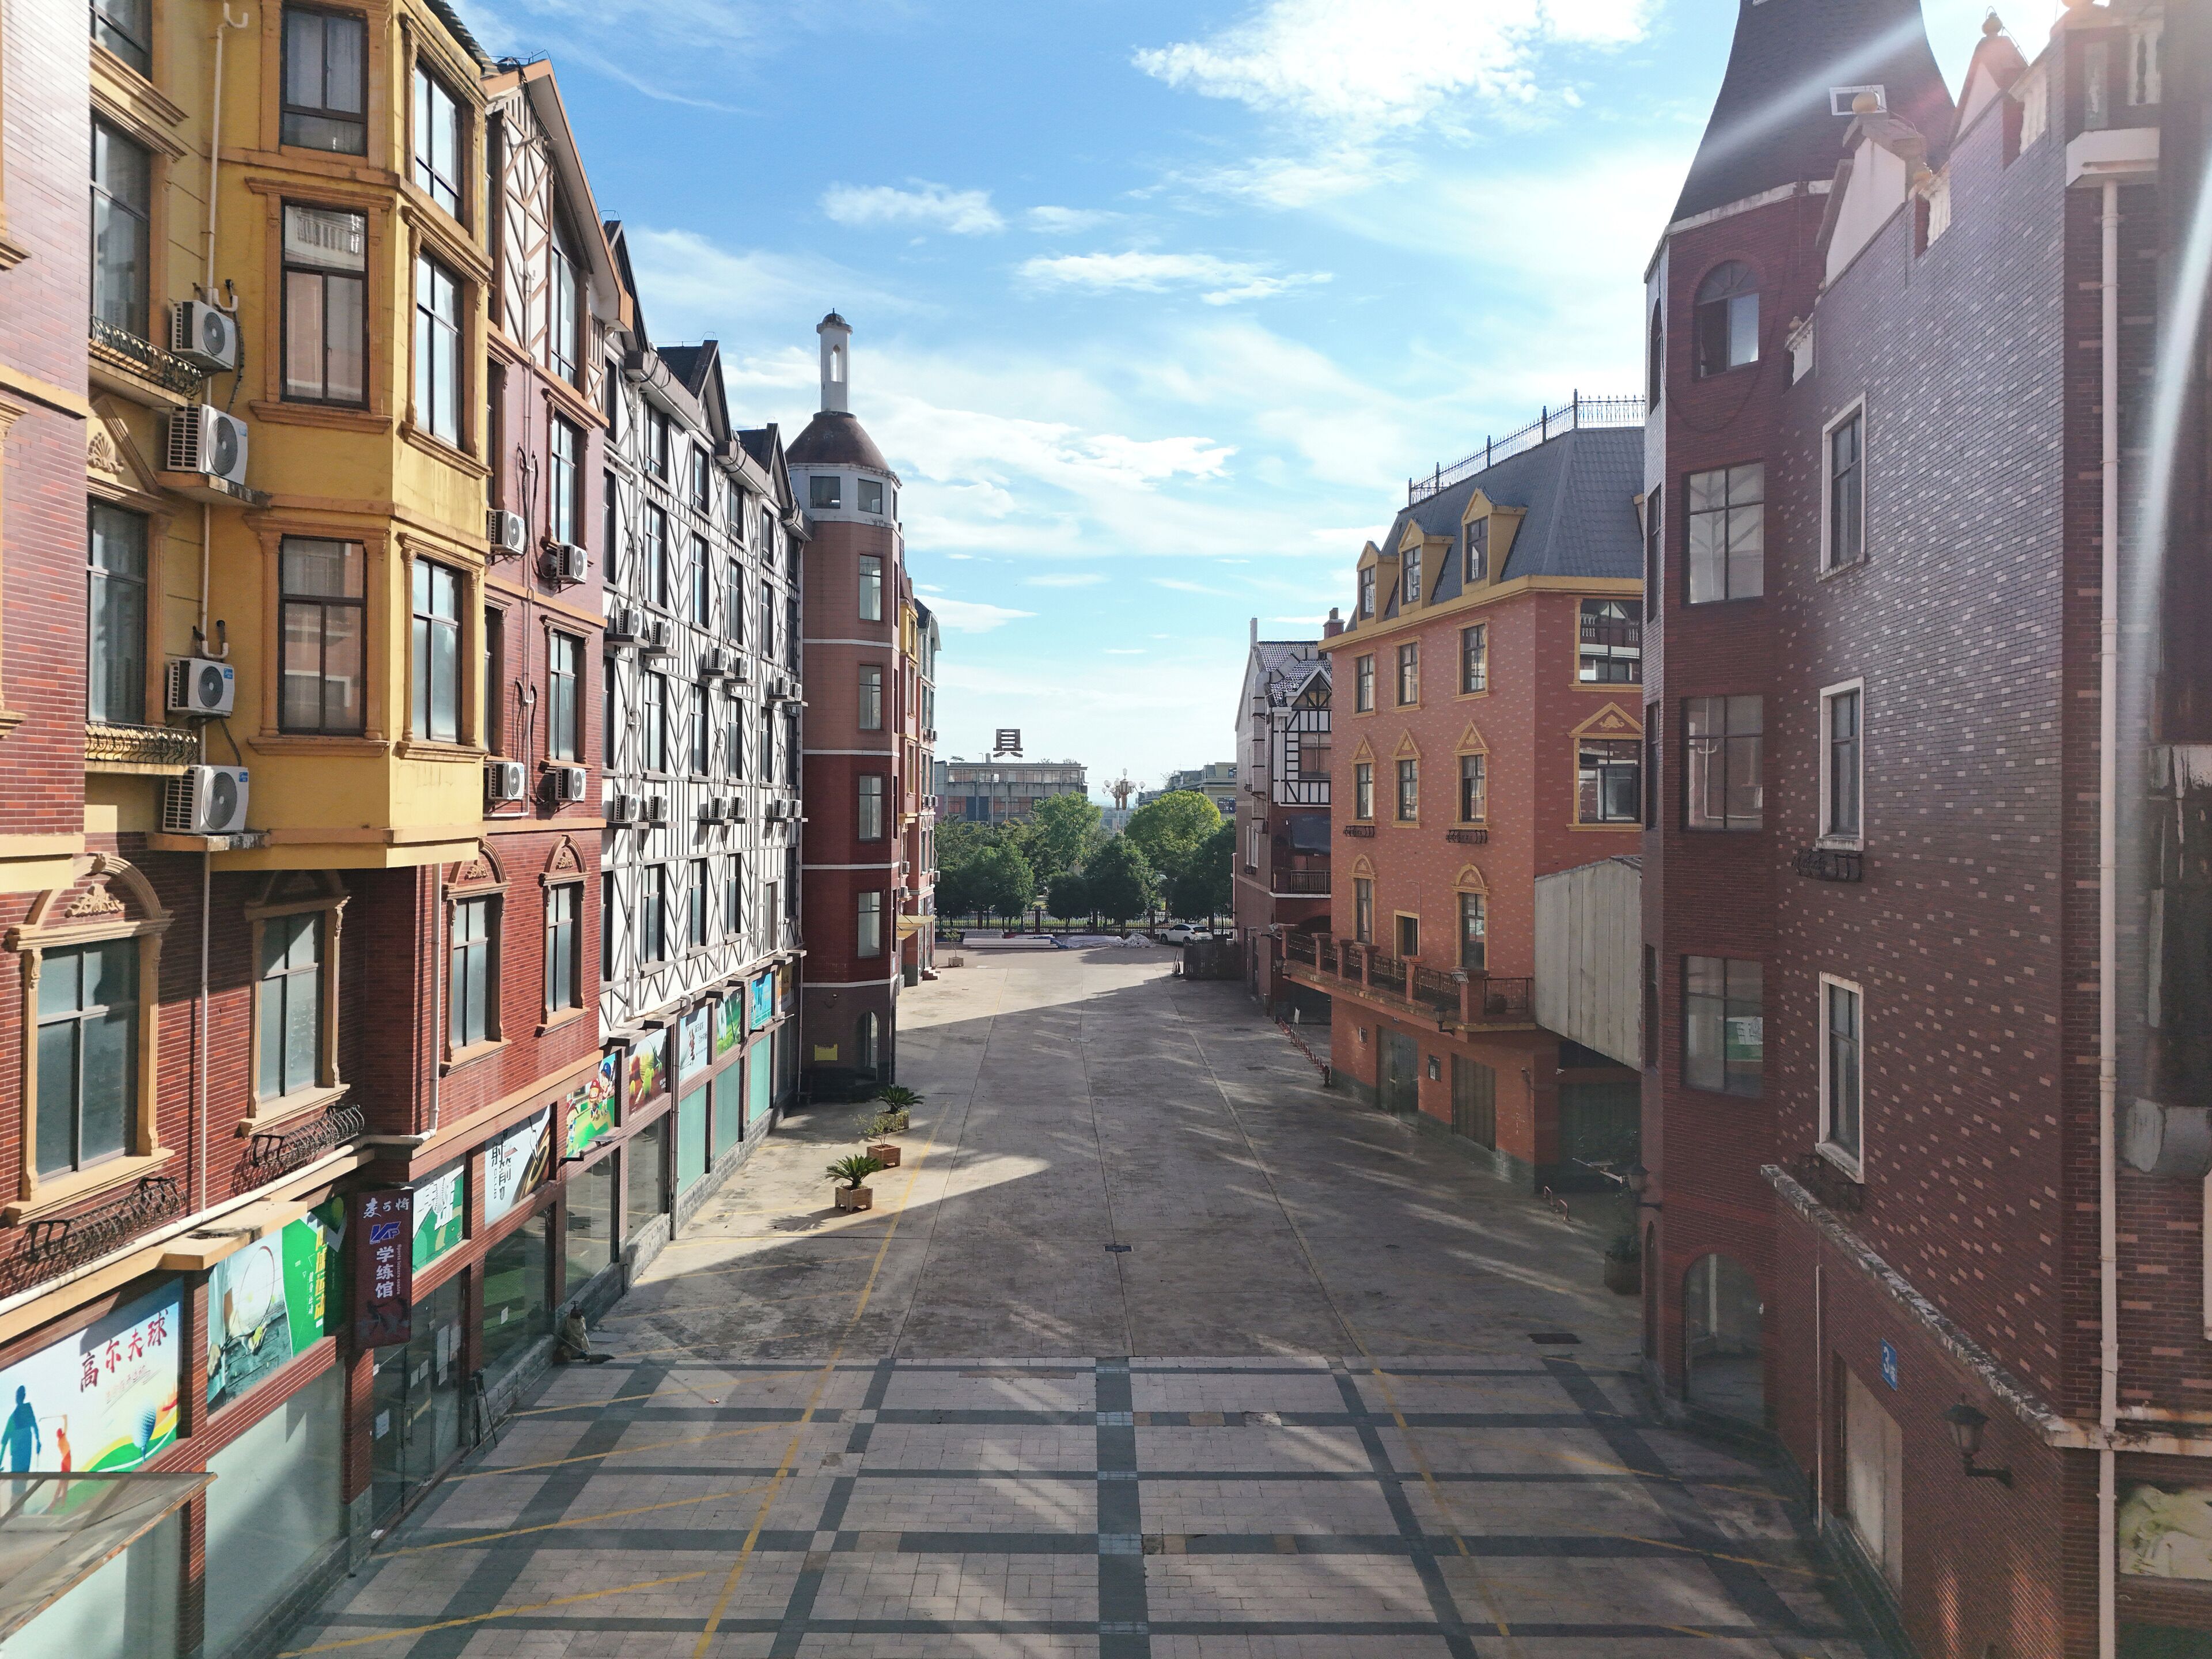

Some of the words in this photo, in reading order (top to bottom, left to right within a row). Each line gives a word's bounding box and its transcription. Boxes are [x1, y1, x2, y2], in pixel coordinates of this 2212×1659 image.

[375, 1245, 394, 1299] 学练馆
[80, 1308, 168, 1393] 高尔夫球
